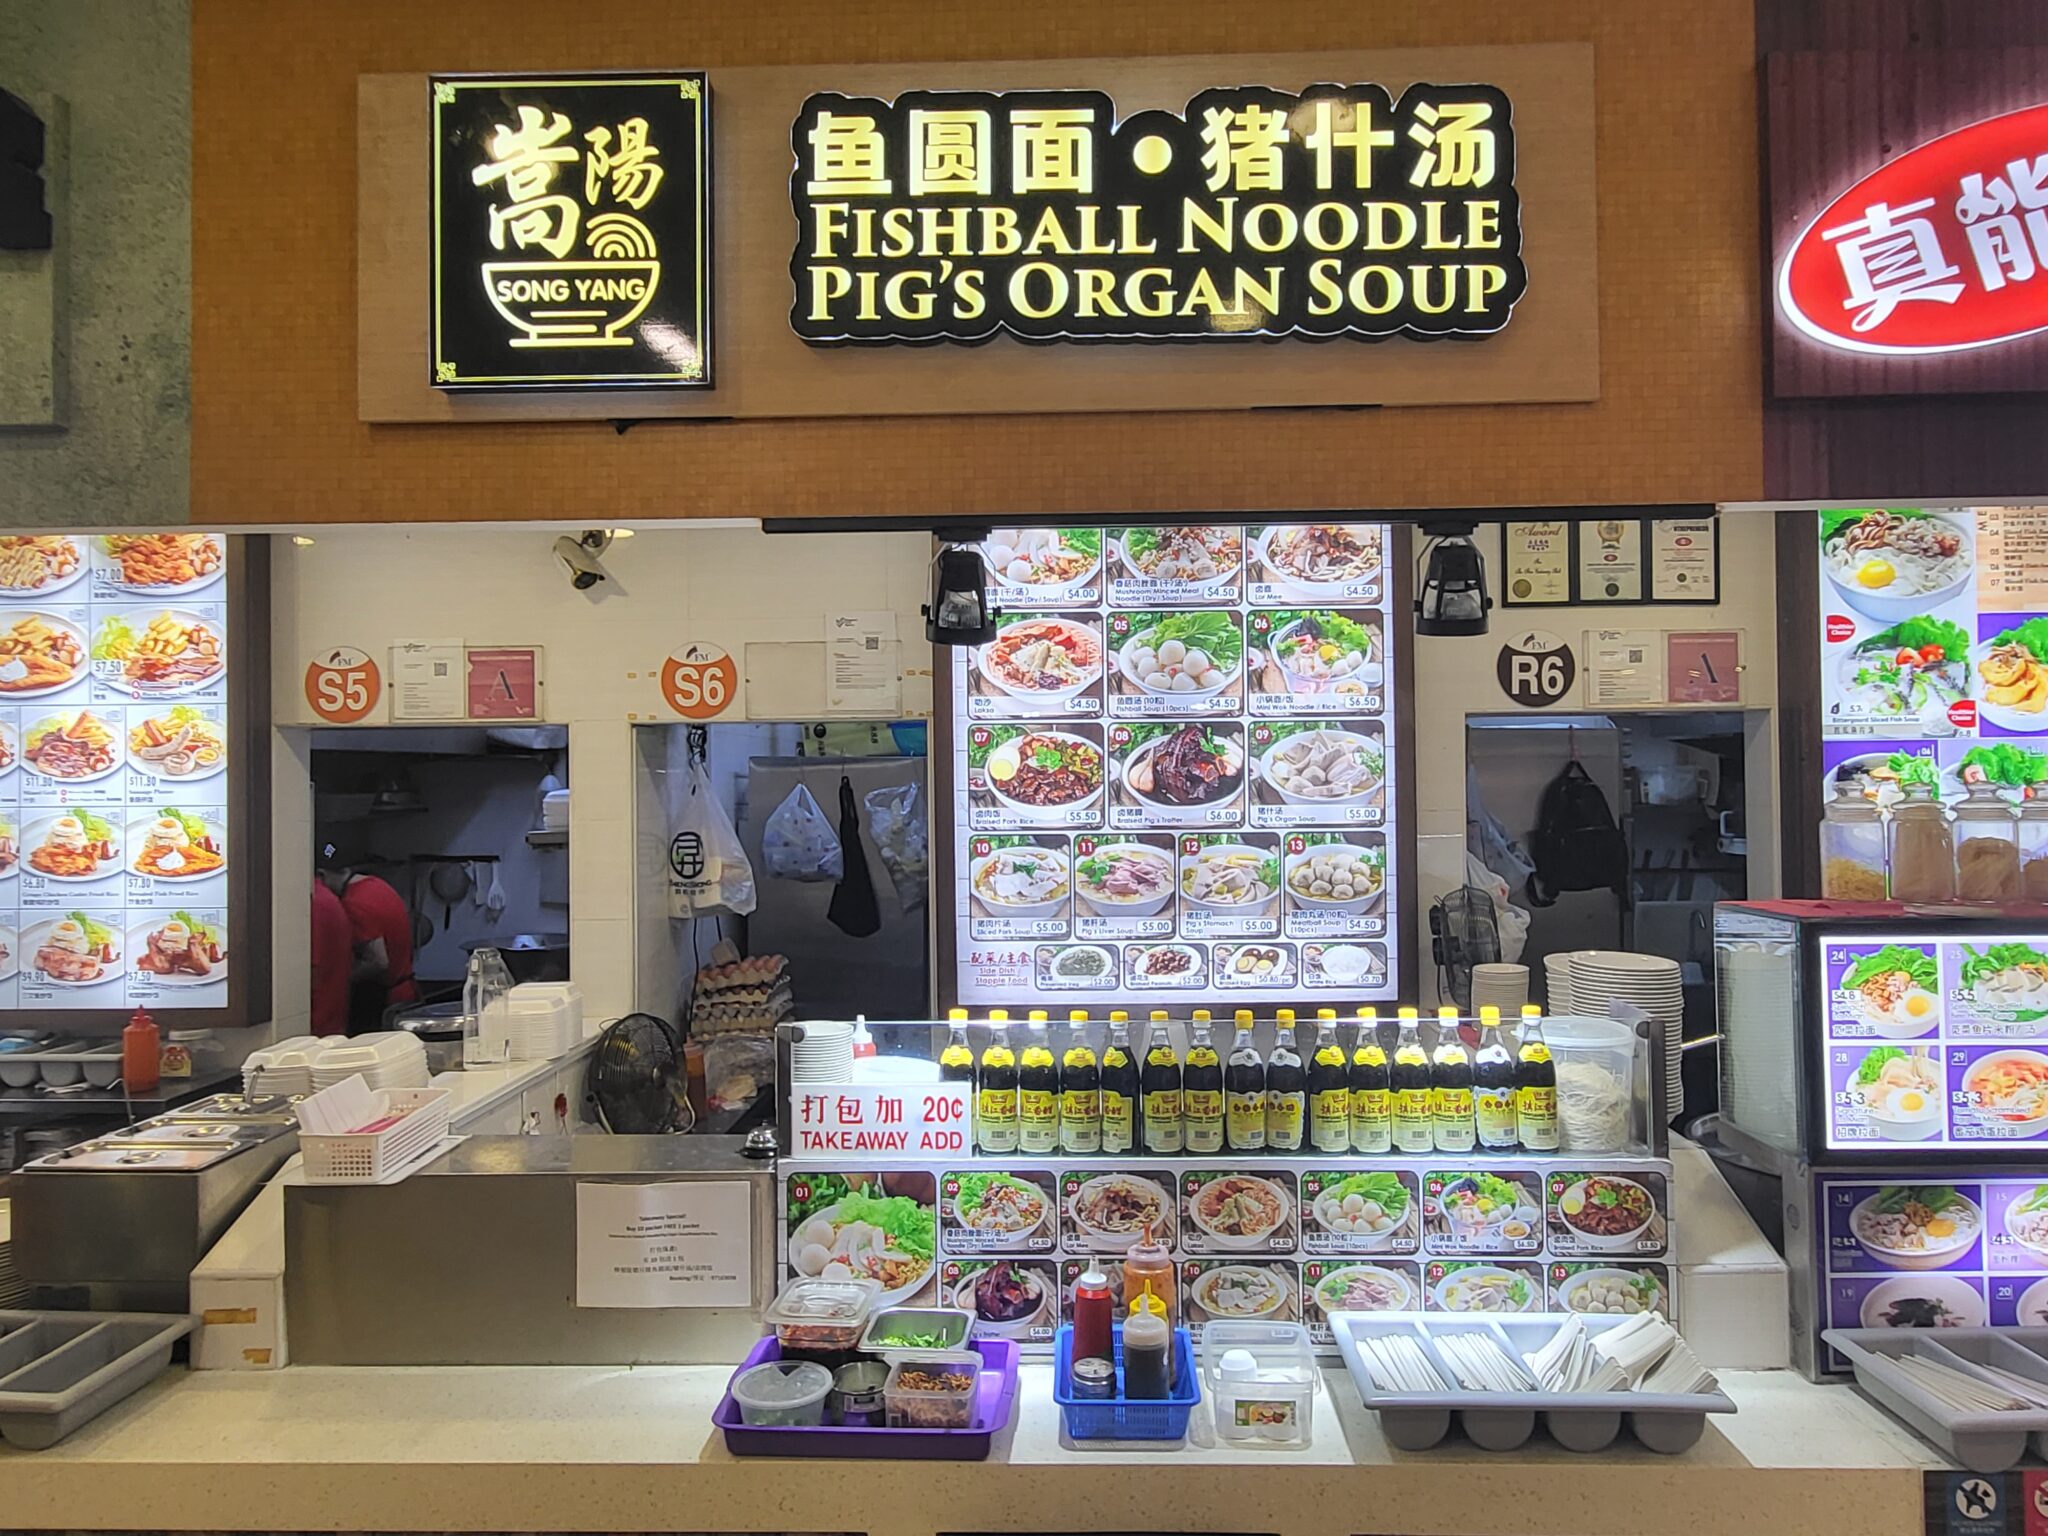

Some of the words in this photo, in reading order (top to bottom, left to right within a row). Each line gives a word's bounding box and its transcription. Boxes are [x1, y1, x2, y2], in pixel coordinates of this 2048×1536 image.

[809, 200, 1157, 259] FISHBALL
[1178, 196, 1502, 254] NOODLE
[497, 279, 569, 303] SONG
[574, 278, 647, 302] YANG
[807, 260, 986, 321] PIG'S
[1008, 260, 1286, 318] ORGAN
[1307, 259, 1508, 315] SOUP
[1068, 588, 1095, 599] $4.00
[1207, 587, 1235, 597] $4.50
[1346, 585, 1374, 596] $4.50
[1113, 620, 1128, 630] 05
[1254, 619, 1268, 629] 06
[1511, 656, 1565, 696] R6
[484, 669, 518, 701] A
[674, 667, 725, 707] S6
[317, 672, 368, 712] S5
[1070, 699, 1097, 710] $4.50
[1209, 699, 1236, 708] $4.50
[1349, 696, 1377, 707] $6.50
[1143, 705, 1161, 713] Soup
[974, 733, 988, 742] 07
[1115, 732, 1129, 741] 08
[1255, 730, 1269, 740] 09
[1069, 811, 1097, 821] $5.50
[1210, 810, 1238, 821] $6.00
[1275, 815, 1297, 823] Organ
[1298, 815, 1316, 823] Soup
[1349, 809, 1377, 819] $5.00
[975, 843, 989, 853] 10
[1080, 842, 1093, 852] 11
[1185, 842, 1199, 851] 12
[1290, 840, 1304, 850] 13
[1036, 922, 1063, 932] $5.00
[1142, 921, 1170, 931] $5.00
[1245, 920, 1273, 930] $5.00
[1323, 919, 1341, 927] Soup
[1349, 919, 1377, 929] $4.50
[1014, 928, 1031, 936] Soup
[1116, 927, 1134, 935] Soup
[1831, 951, 1844, 960] 24
[1950, 951, 1962, 959] 25
[979, 967, 996, 975] Side
[998, 967, 1016, 975] Dish
[1007, 977, 1028, 986] Food
[1093, 978, 1114, 986] $2.00
[1182, 976, 1203, 984] $2.00
[1835, 1053, 1848, 1062] 28
[1952, 1052, 1965, 1061] 29
[801, 1094, 903, 1125] 打包加
[922, 1096, 963, 1124] 20¢
[800, 1131, 909, 1151] TAKEAWAY
[919, 1131, 963, 1151] ADD
[946, 1182, 959, 1193] 02
[1066, 1182, 1079, 1192] 03
[1186, 1182, 1200, 1192] 04
[1306, 1182, 1320, 1192] 05
[1429, 1183, 1442, 1193] 06
[1551, 1183, 1565, 1194] 07
[795, 1187, 809, 1199] 01
[1838, 1194, 1849, 1203] 14
[947, 1265, 960, 1276] 08
[1067, 1265, 1079, 1276] 09
[1188, 1266, 1200, 1276] 10
[1309, 1266, 1320, 1277] 11
[1431, 1266, 1444, 1277] 12
[1553, 1267, 1567, 1278] 13
[1998, 1287, 2010, 1297] 20
